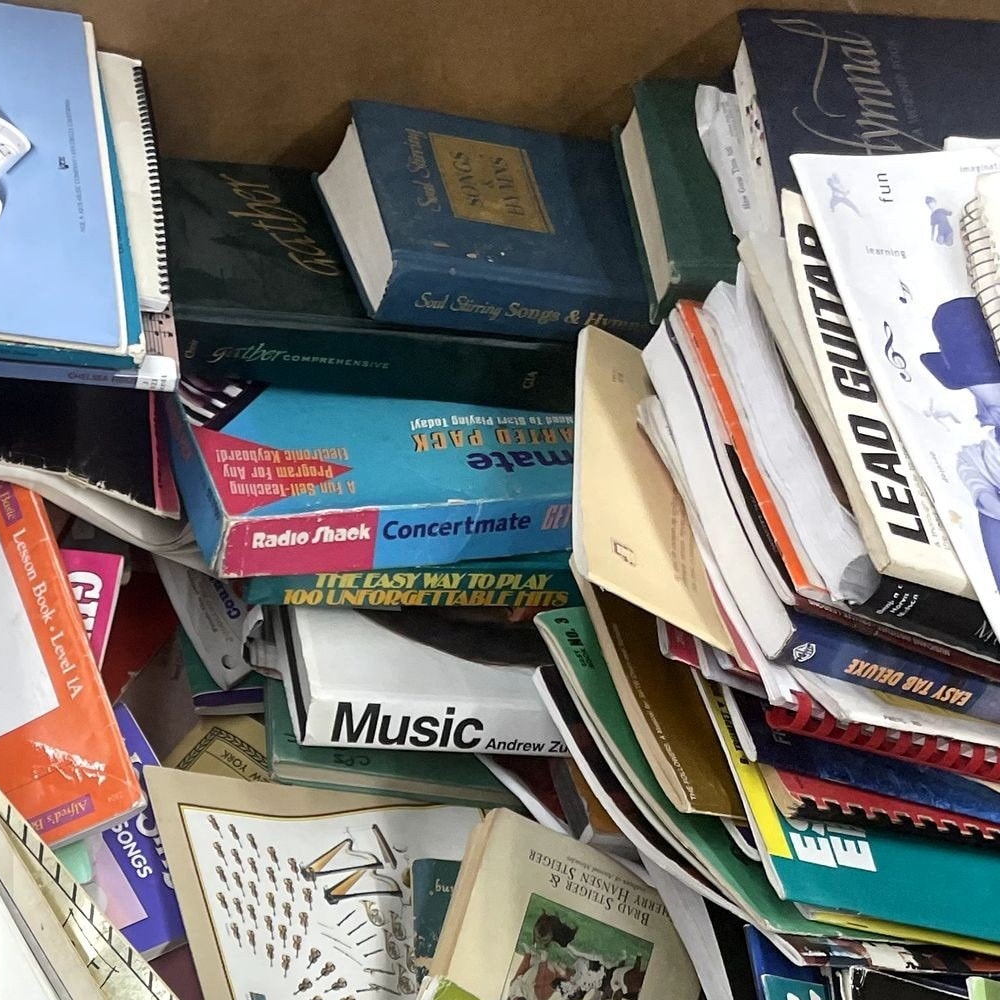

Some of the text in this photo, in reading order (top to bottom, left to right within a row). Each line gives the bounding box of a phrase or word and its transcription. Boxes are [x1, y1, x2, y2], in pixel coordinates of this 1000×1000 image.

[875, 171, 895, 204] fun
[864, 244, 908, 260] learning
[414, 291, 580, 325] Soul Stirring Songs &
[797, 222, 878, 404] GUITAR
[282, 353, 391, 370] COMPREHENSIVE
[409, 417, 449, 432] Today!
[450, 414, 495, 429] Playing
[214, 446, 349, 465] Electronic Keyboard!
[411, 428, 484, 454] PACK
[222, 463, 334, 480] Program For Any
[848, 413, 930, 545] LEAD
[230, 480, 357, 497] A Fun Self-Teaching
[250, 522, 372, 551] Radio Shack
[382, 512, 532, 542] Concertmate
[314, 571, 555, 591] THE EASY WAY TO PLAY
[283, 589, 571, 607] 100 UNFORGETTABLE HITS
[9, 527, 37, 585] Lesson
[31, 581, 55, 624] Book
[50, 632, 75, 678] Level
[65, 674, 84, 701] 1A
[843, 658, 974, 707] EASY TAB DELUXE
[331, 701, 545, 754] Music Andrew
[47, 795, 91, 826] Alfred's
[112, 820, 154, 880] SONGS
[527, 848, 576, 880] STEIGER
[546, 872, 650, 926] BRAD STEIGER &
[580, 871, 630, 902] HANSEN
